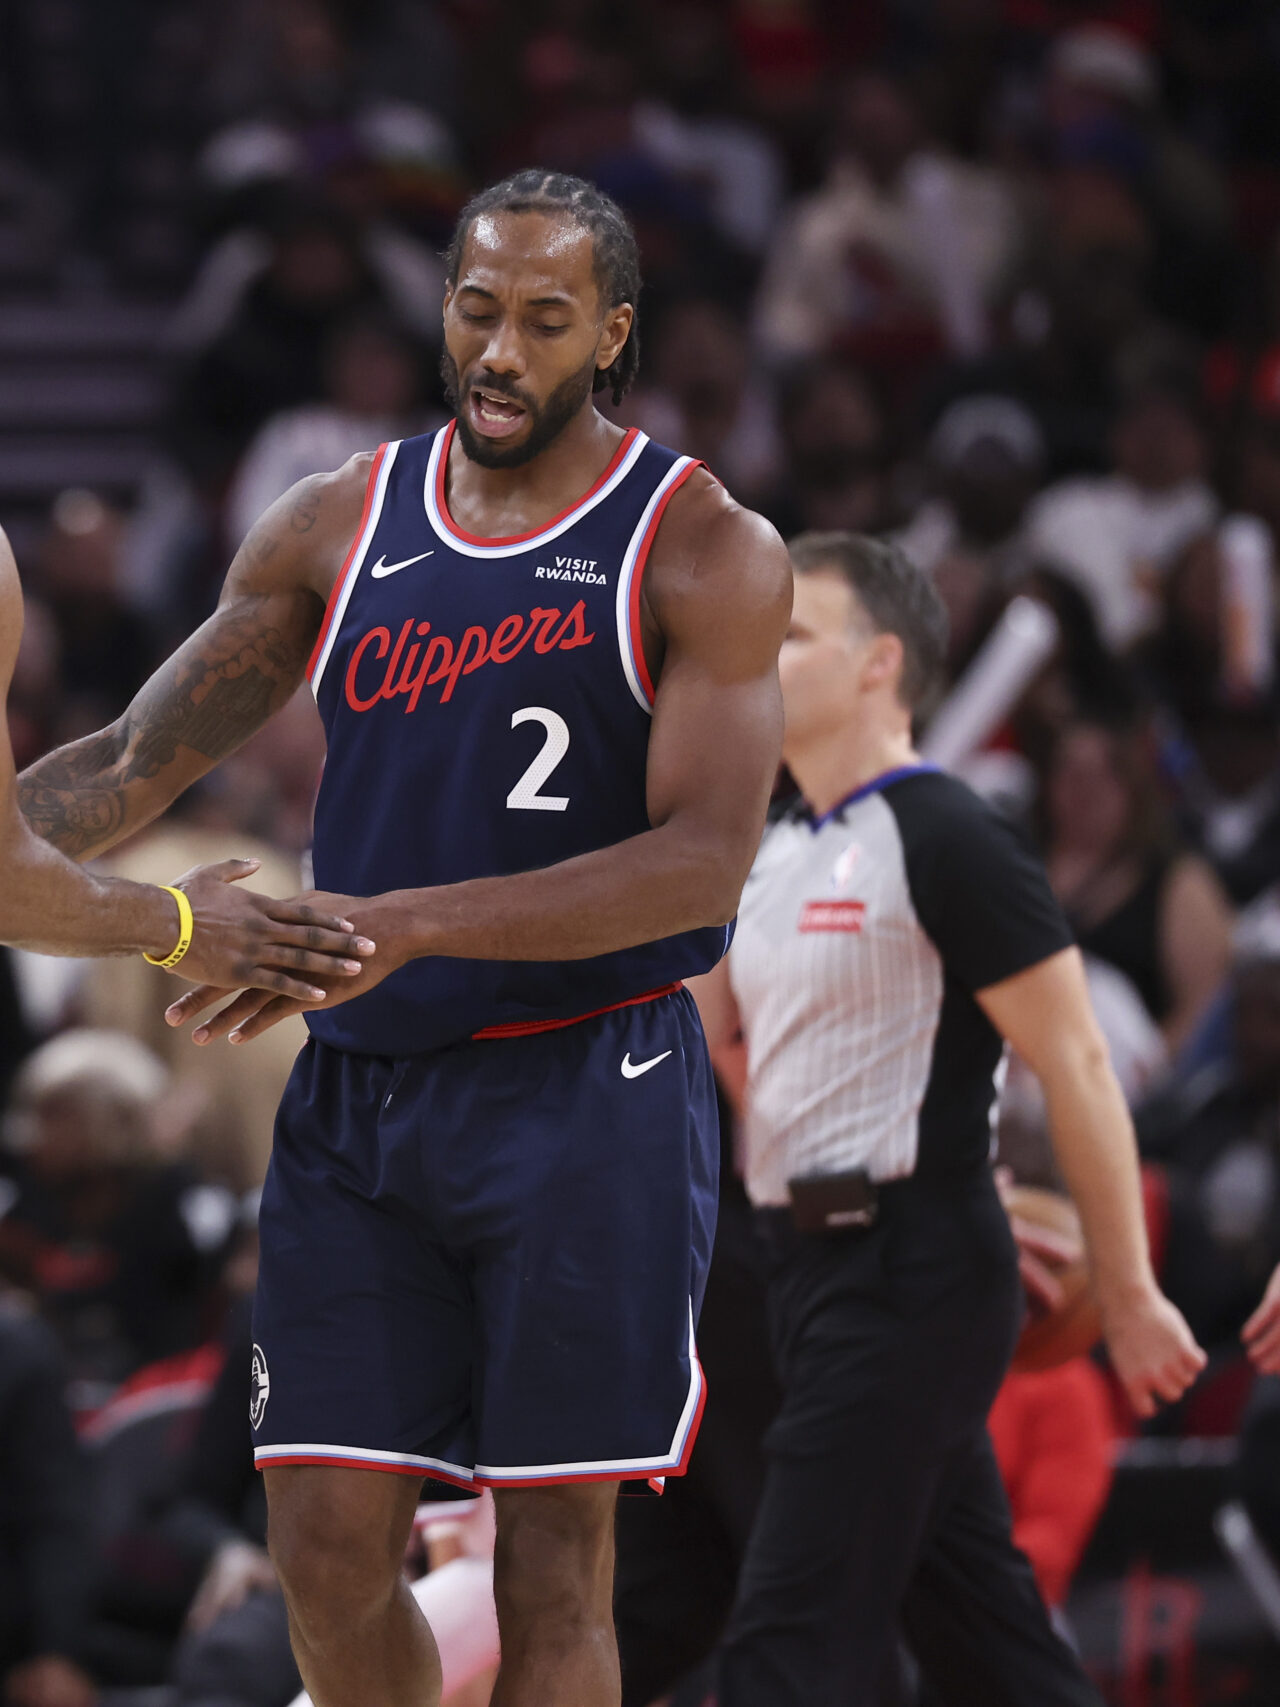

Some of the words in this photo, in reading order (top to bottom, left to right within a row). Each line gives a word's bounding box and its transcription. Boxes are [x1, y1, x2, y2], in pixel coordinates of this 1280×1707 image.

[535, 566, 607, 585] RWANDA
[555, 556, 597, 572] VISIT
[345, 600, 595, 713] Clippers
[507, 706, 570, 811] 2
